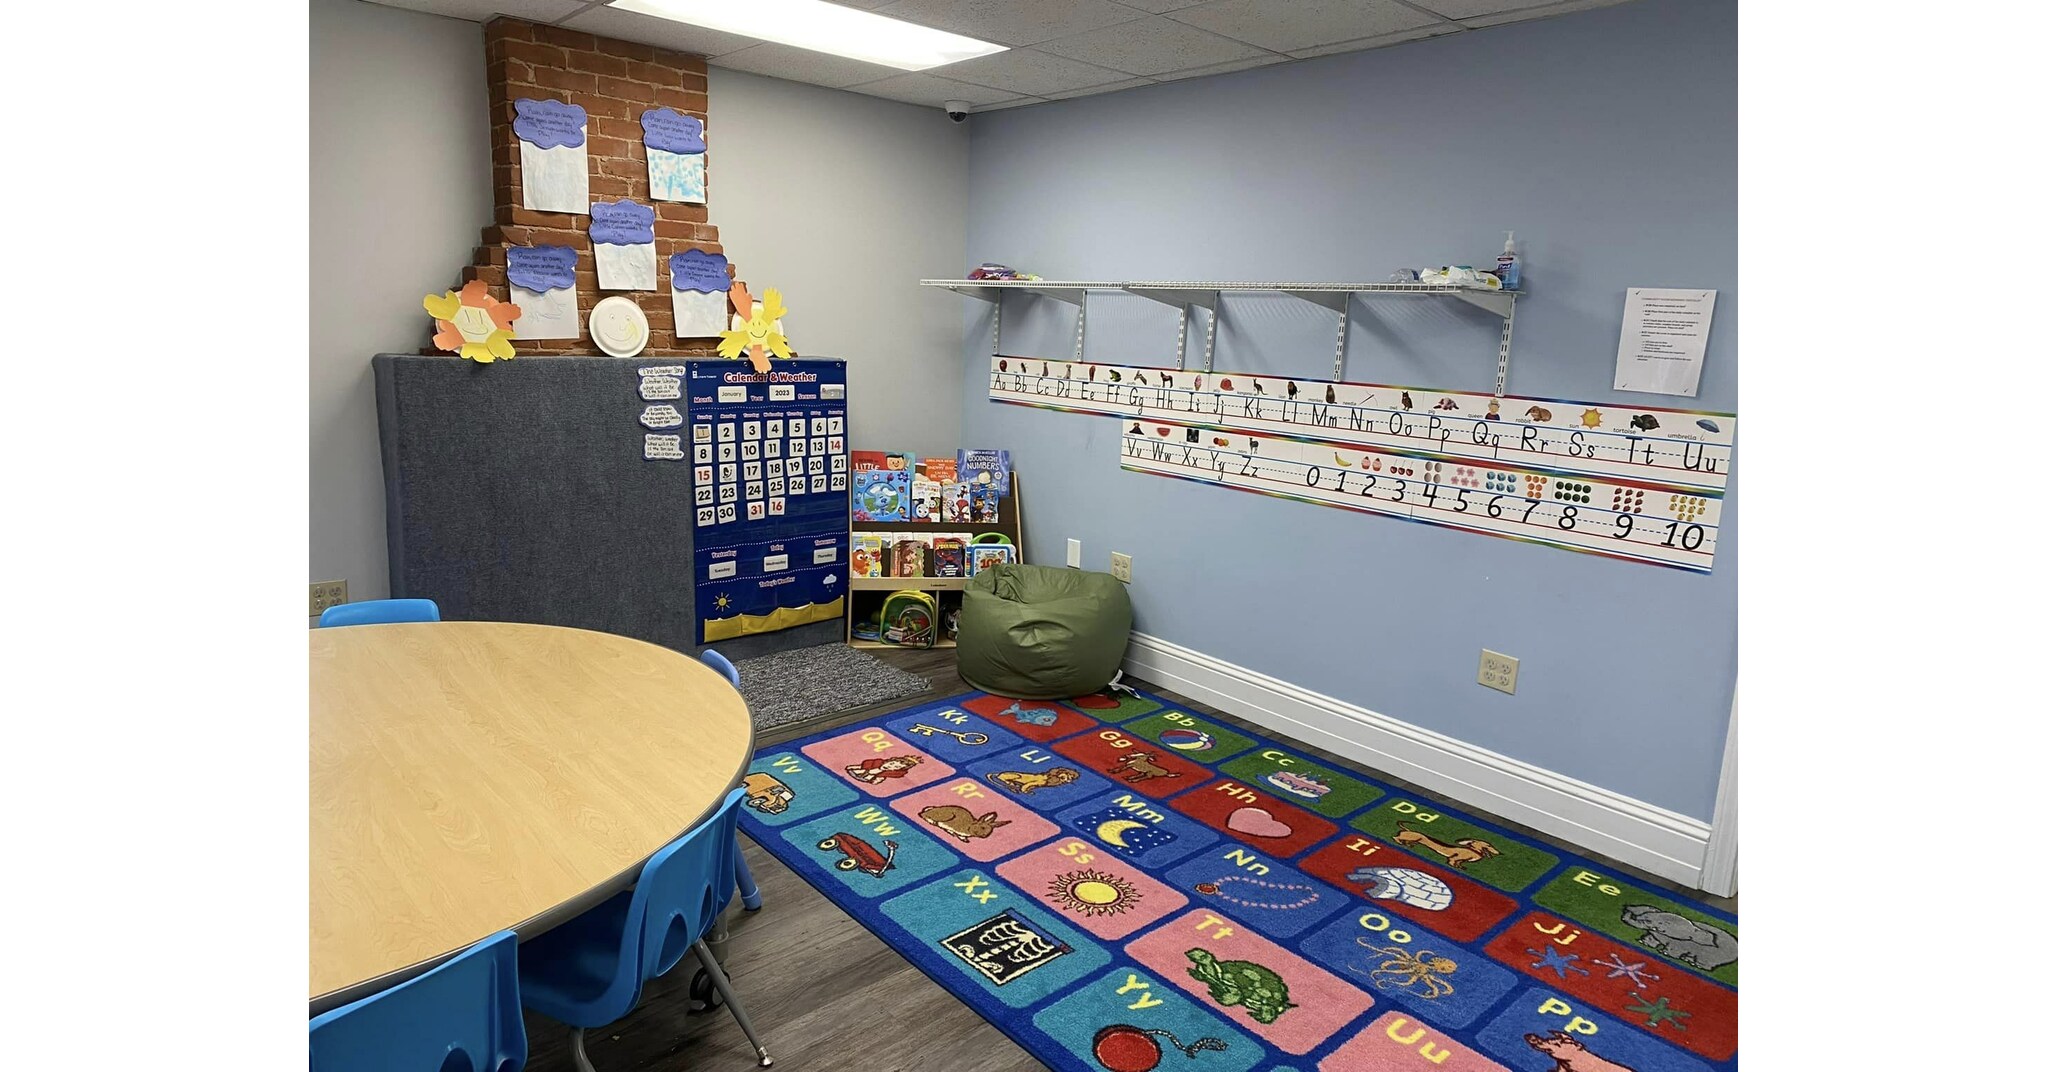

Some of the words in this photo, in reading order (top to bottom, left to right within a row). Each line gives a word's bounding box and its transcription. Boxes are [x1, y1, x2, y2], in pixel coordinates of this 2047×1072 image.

[724, 372, 768, 383] Calendar
[770, 372, 778, 382] &
[778, 372, 817, 382] Weather
[723, 427, 730, 437] 2
[749, 425, 756, 435] 3
[772, 424, 779, 433] 4
[794, 423, 800, 432] 5
[816, 422, 822, 432] 6
[833, 421, 838, 430] 7
[994, 374, 1006, 390] Aa
[1015, 375, 1027, 392] Bb
[1037, 377, 1049, 395] Cc
[1057, 380, 1070, 398] Dd
[1081, 382, 1094, 400] Ee
[1107, 385, 1120, 403] Ff
[1130, 387, 1144, 415] Gg
[1157, 389, 1173, 409] Hh
[1188, 392, 1200, 412] Ii
[1213, 394, 1224, 424] Jj
[1244, 397, 1262, 419] Kk
[1282, 401, 1298, 423] Ll
[1312, 404, 1338, 428] Mm
[1350, 408, 1373, 432] Nn
[1389, 412, 1412, 436] Oo
[1428, 416, 1450, 452] Pp
[1473, 421, 1500, 459] Qq
[1521, 426, 1549, 452] Rr
[1569, 432, 1595, 458] Ss
[1626, 437, 1654, 465] Tt
[1684, 442, 1717, 472] Uu
[700, 449, 707, 459] 8
[724, 448, 731, 458] 9
[744, 445, 757, 455] 10
[769, 444, 776, 453] 11
[792, 443, 803, 452] 12
[813, 442, 823, 451] 13
[831, 441, 841, 450] 14
[698, 470, 710, 480] 15
[746, 466, 758, 476] 17
[770, 464, 780, 473] 18
[789, 461, 800, 472] 19
[810, 461, 822, 470] 20
[834, 459, 844, 468] 21
[967, 462, 1000, 470] NUMBERS
[698, 490, 711, 501] 22
[722, 488, 735, 498] 23
[748, 485, 761, 495] 24
[770, 481, 782, 491] 25
[791, 480, 803, 490] 26
[814, 479, 824, 488] 27
[833, 477, 845, 486] 28
[1127, 438, 1142, 458] Vv
[1152, 441, 1172, 462] Ww
[1182, 446, 1198, 467] Xx
[1210, 451, 1226, 481] Yy
[1240, 455, 1259, 477] Zz
[1334, 471, 1346, 492] 1
[1361, 475, 1376, 497] 2
[1391, 479, 1406, 502] 3
[1422, 484, 1437, 507] 4
[1453, 489, 1471, 513] 5
[1487, 496, 1502, 518] 6
[1520, 499, 1540, 524] 7
[1558, 505, 1579, 530] 8
[1612, 514, 1633, 539] 9
[1660, 522, 1705, 550] 10
[700, 510, 713, 521] 29
[719, 507, 733, 519] 30
[751, 505, 762, 515] 31
[771, 502, 782, 511] 16
[711, 550, 737, 558] Yesterday
[938, 709, 967, 725] Kk
[1163, 712, 1194, 728] Bb
[860, 731, 897, 753] Qq
[1099, 730, 1133, 749] Gg
[770, 757, 802, 774] Vv
[1020, 750, 1051, 763] Ll
[1261, 749, 1295, 767] Cc
[950, 782, 985, 801] Rr
[1216, 782, 1258, 804] Hh
[1111, 795, 1165, 823] Mm
[1391, 802, 1440, 823] Dd
[853, 806, 901, 837] Ww
[1057, 843, 1094, 865] Ss
[1345, 838, 1381, 857] Ii
[1223, 848, 1272, 876] Nn
[954, 876, 998, 904] Xx
[1572, 871, 1621, 898] Ee
[1194, 915, 1234, 940] Tt
[1358, 913, 1413, 944] Oo
[1532, 918, 1581, 946] Jj
[1115, 974, 1164, 1011] Yy
[1537, 997, 1599, 1037] Pp
[1386, 1018, 1451, 1064] Uu
